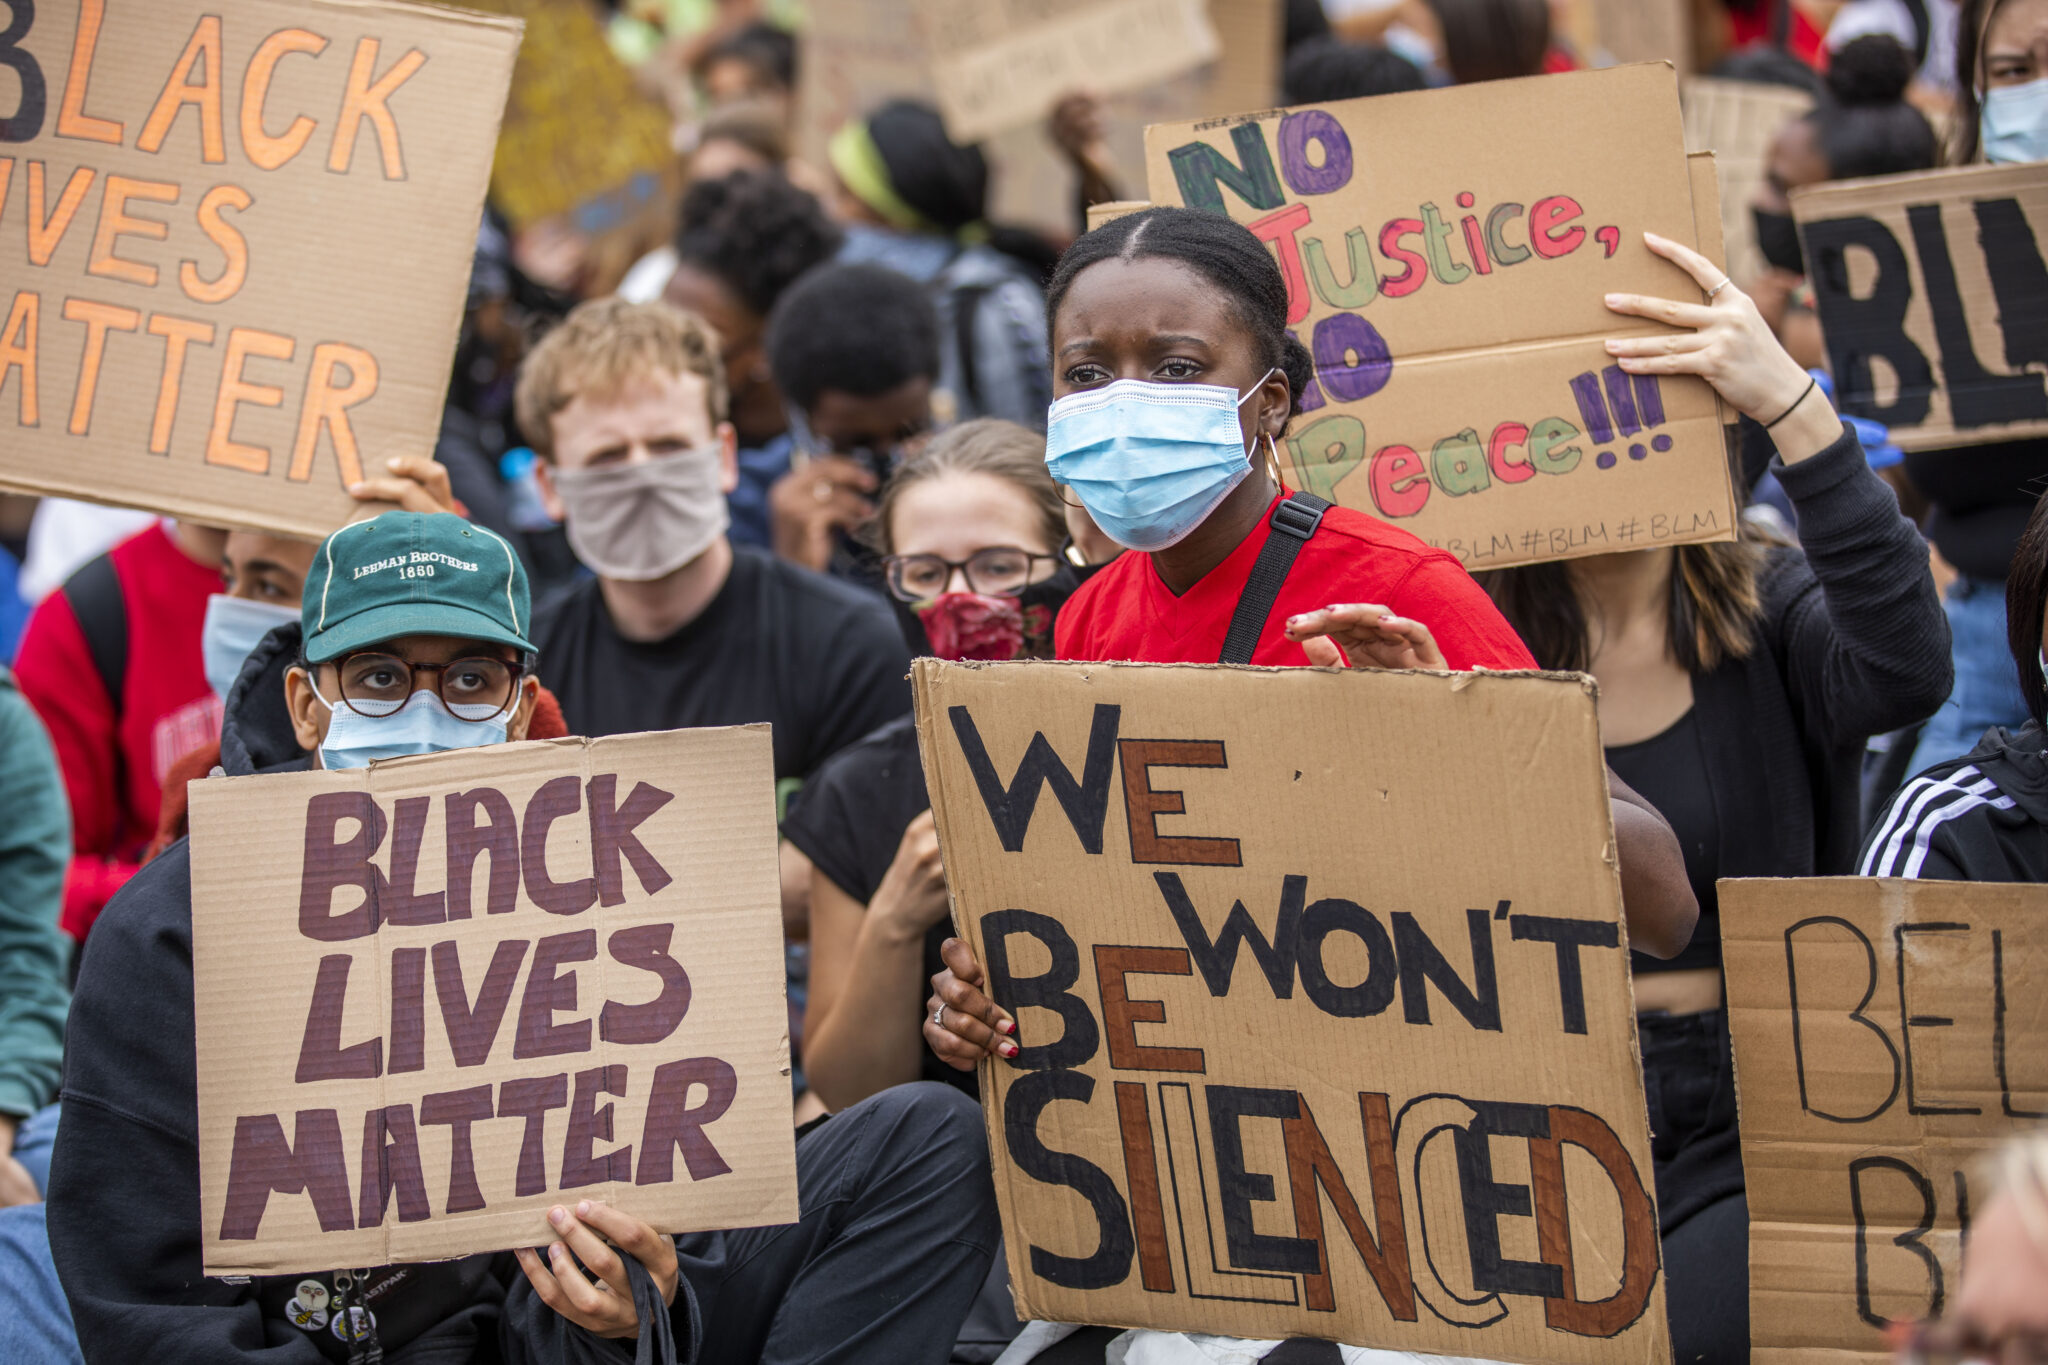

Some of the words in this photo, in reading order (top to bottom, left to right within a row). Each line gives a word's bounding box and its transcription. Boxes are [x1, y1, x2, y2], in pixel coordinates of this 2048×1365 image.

[1167, 109, 1354, 216] NO
[1285, 311, 1394, 413] O
[1286, 363, 1673, 518] Peace!!!
[353, 555, 407, 580] LEHMAN
[409, 551, 479, 572] BROTHERS
[298, 773, 675, 941] BLACK
[948, 703, 1243, 867] WE
[294, 922, 692, 1083] LIVES
[980, 909, 1206, 1075] BE
[1153, 870, 1621, 1035] WON'T
[219, 1056, 738, 1240] MATTER
[1004, 1069, 1660, 1339] SILENCED
